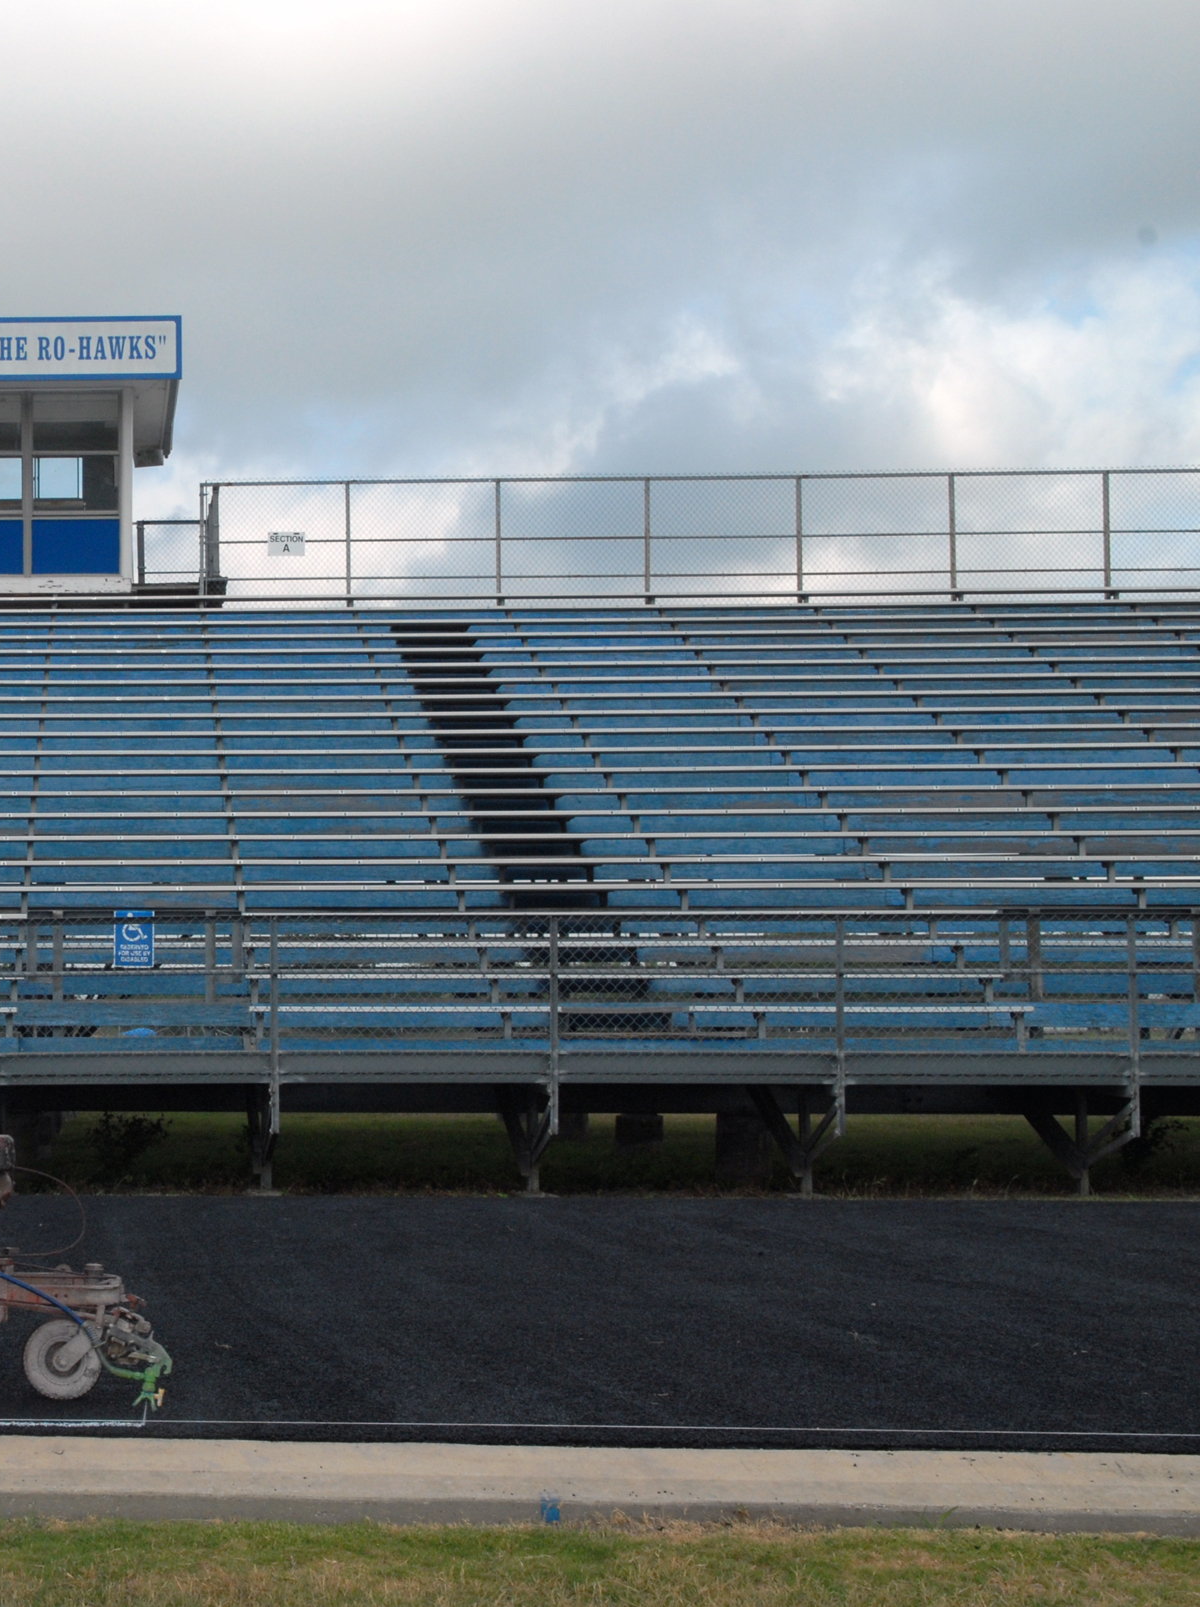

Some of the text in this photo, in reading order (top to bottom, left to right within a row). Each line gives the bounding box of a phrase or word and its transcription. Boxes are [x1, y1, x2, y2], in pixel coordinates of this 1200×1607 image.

[37, 335, 167, 361] RO-HAWKS"
[269, 535, 304, 543] SECTION
[282, 543, 290, 552] A
